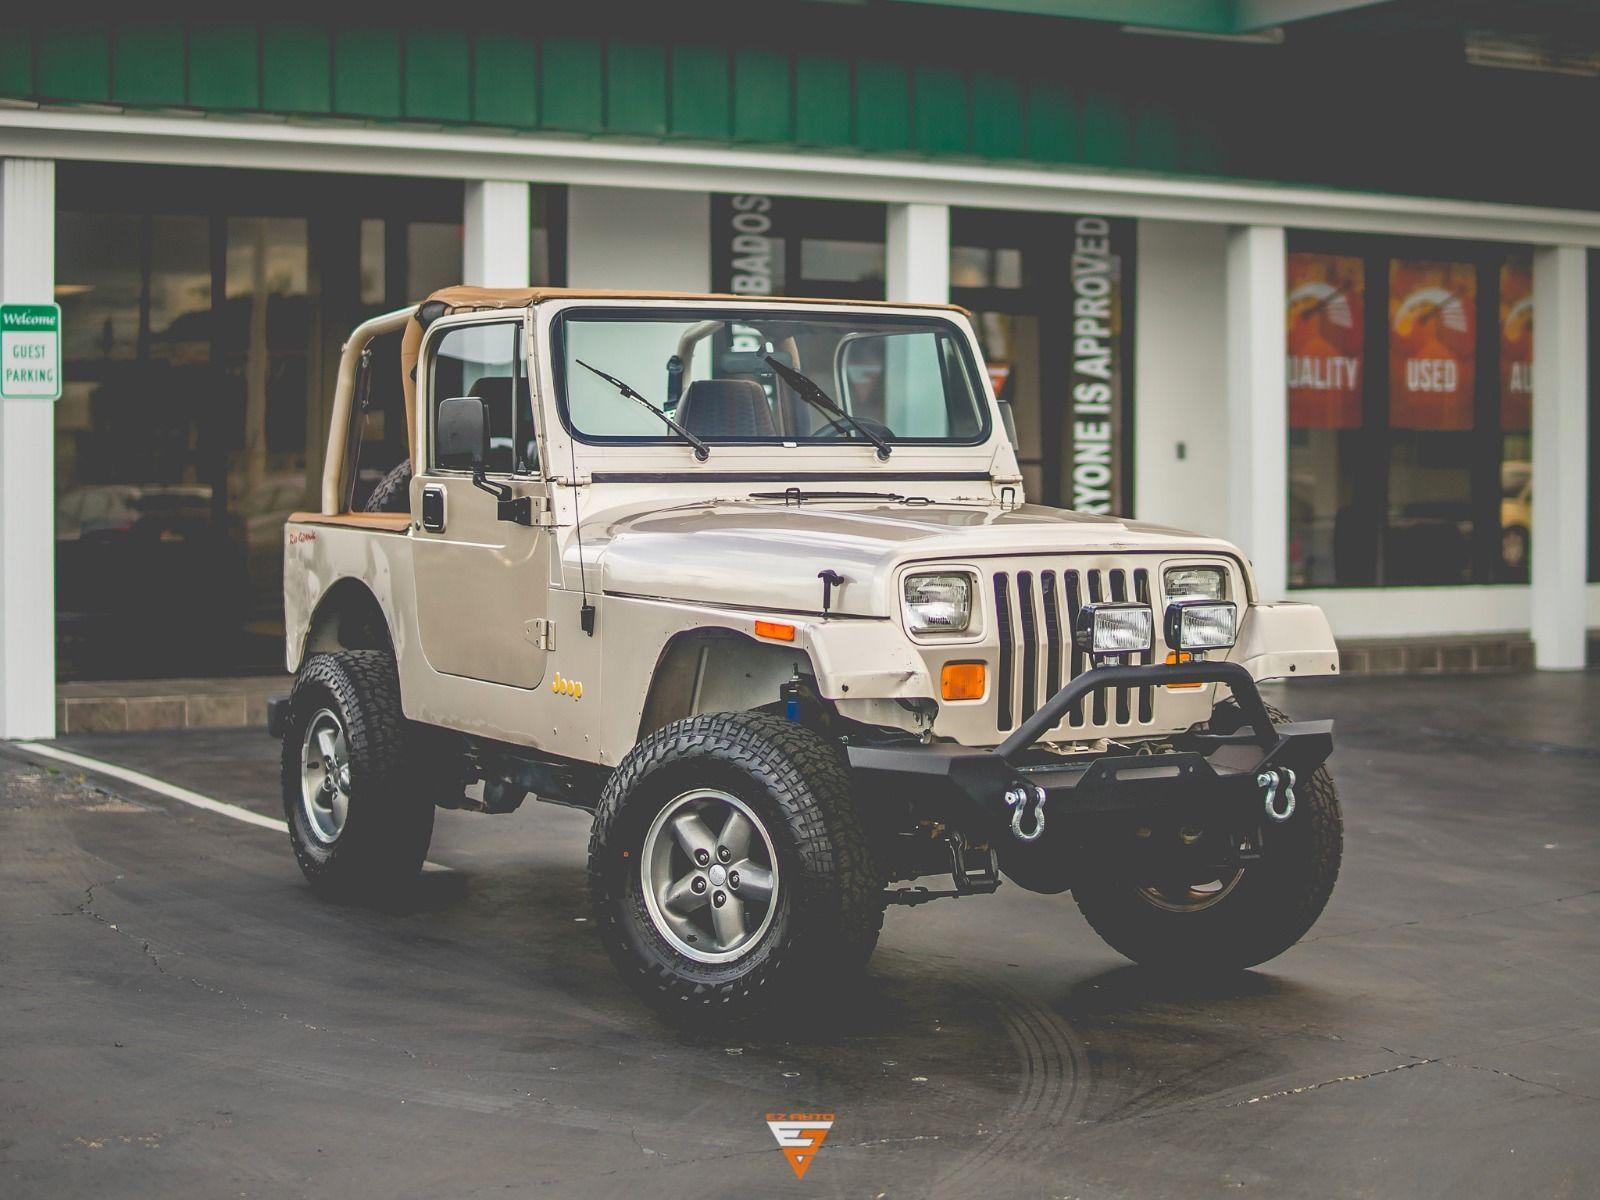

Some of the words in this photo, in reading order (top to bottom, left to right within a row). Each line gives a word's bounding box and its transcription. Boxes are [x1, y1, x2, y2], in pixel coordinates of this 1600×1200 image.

[731, 195, 771, 294] BADOS
[1073, 217, 1112, 378] APPROVED
[3, 311, 56, 325] Welcome
[13, 344, 46, 359] GUEST
[6, 368, 53, 382] PARKING
[1407, 358, 1457, 392] USED
[1073, 383, 1111, 414] IS
